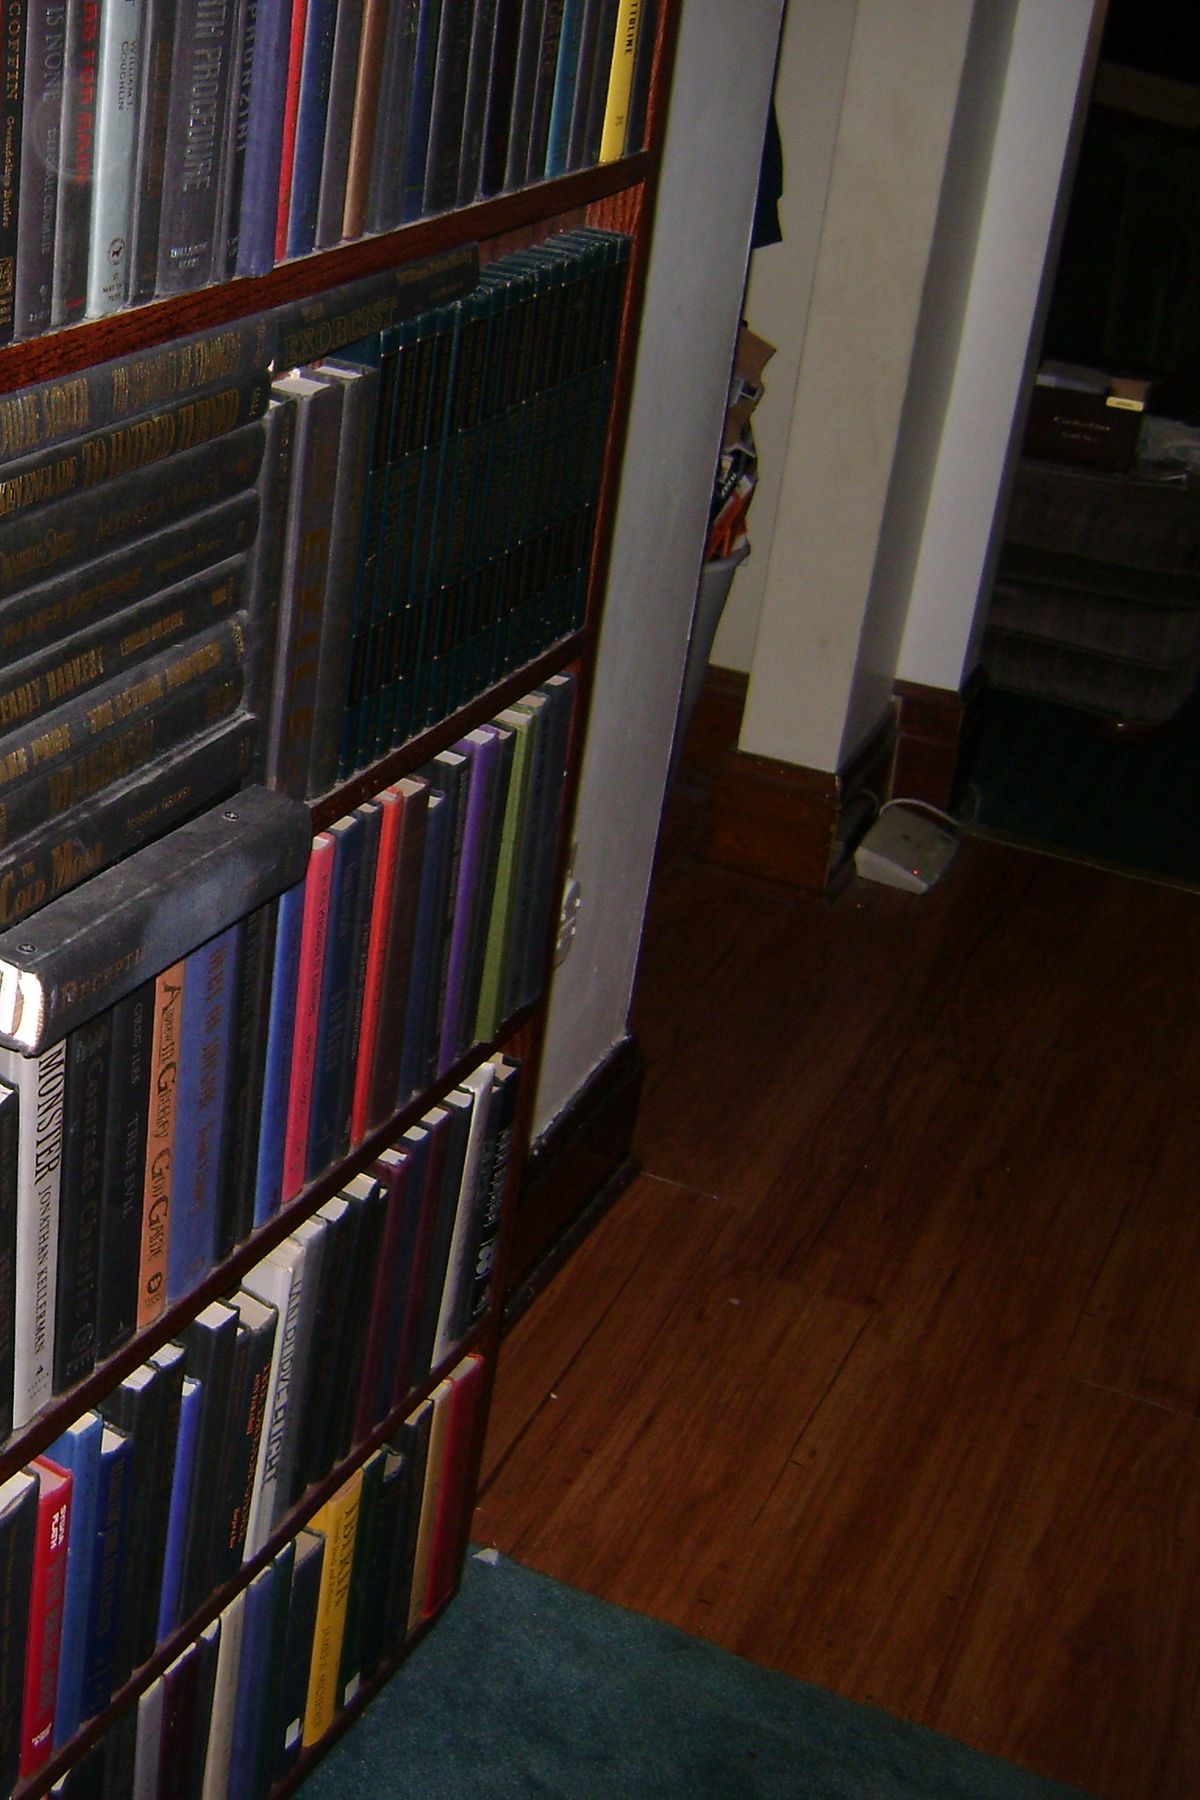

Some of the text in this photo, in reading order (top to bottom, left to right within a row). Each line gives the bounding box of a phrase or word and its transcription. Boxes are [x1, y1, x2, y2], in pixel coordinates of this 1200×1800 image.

[5, 1, 20, 101] COFFIN
[42, 33, 64, 102] NONE
[117, 40, 129, 111] COUGHLIN
[126, 40, 138, 101] WILLIAM
[46, 644, 105, 700] HARVEST
[121, 1001, 142, 1220] GREG ILES TRUE EVIL
[33, 1045, 66, 1355] MONSTER JONATHAN KELLERMAN
[262, 1402, 288, 1489] FLIGHT
[50, 1511, 60, 1550] PLATH
[57, 1503, 67, 1546] SYLVIA
